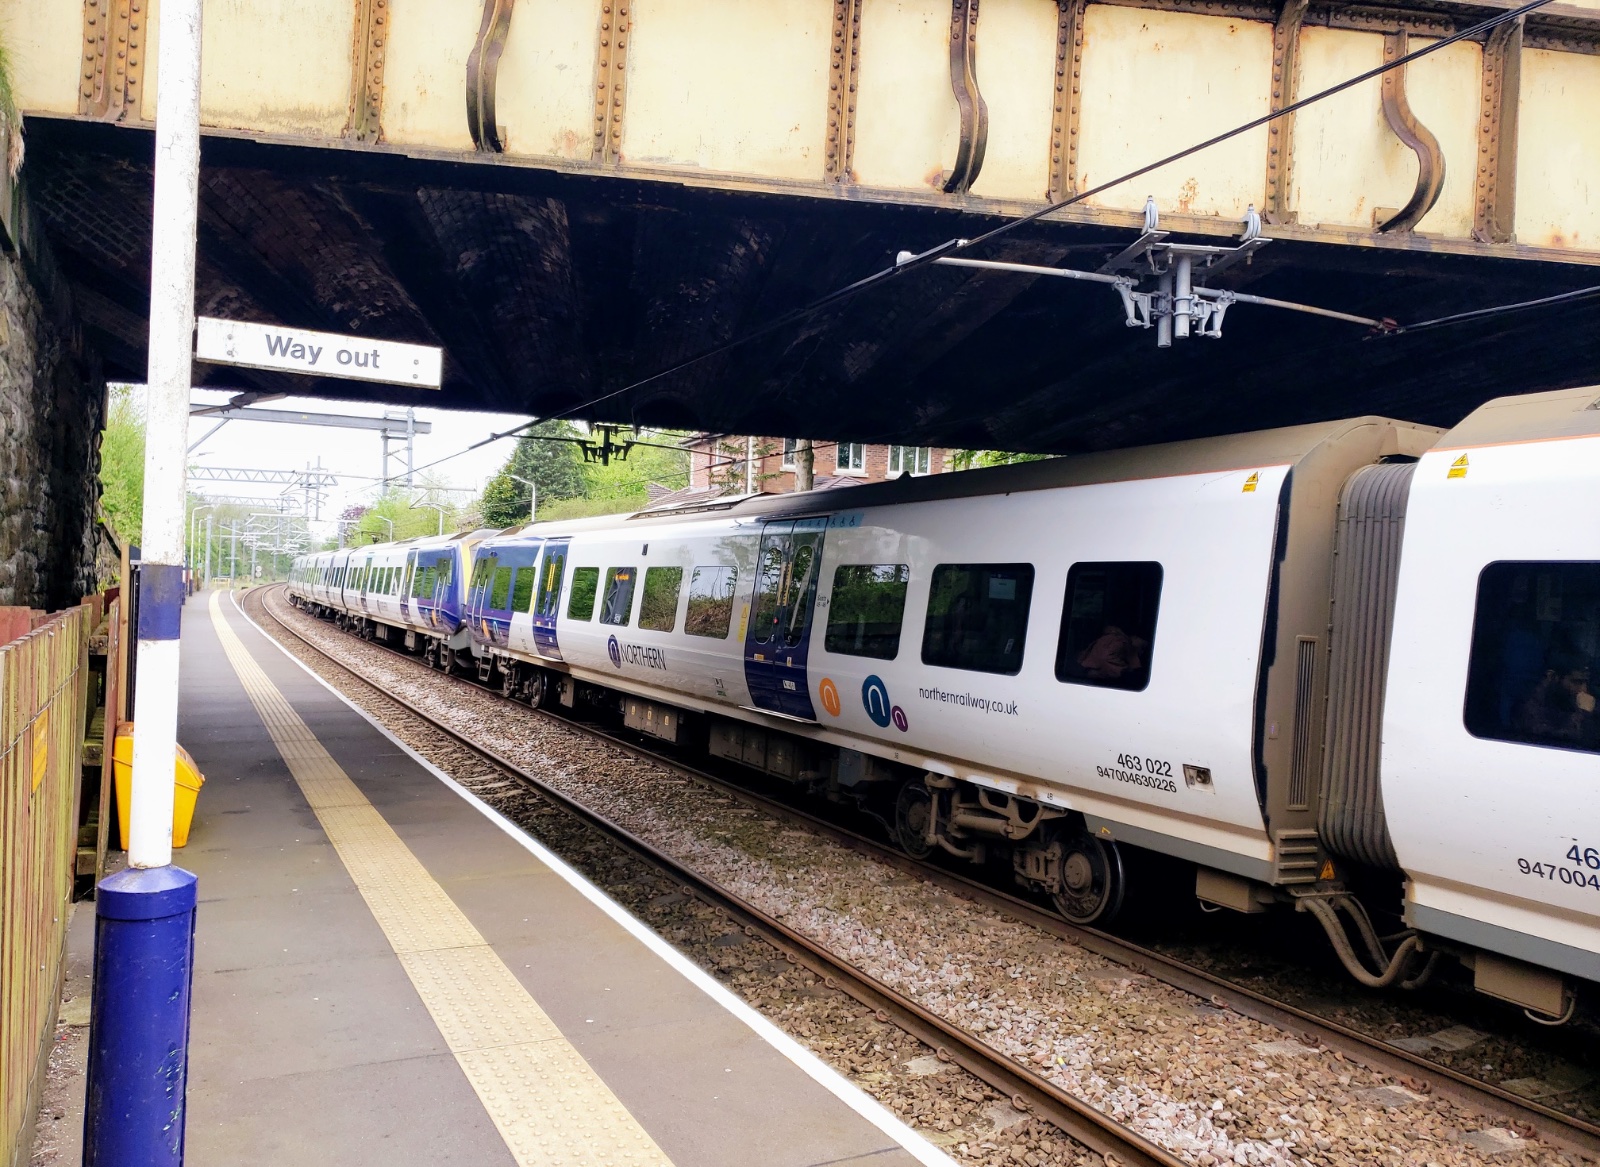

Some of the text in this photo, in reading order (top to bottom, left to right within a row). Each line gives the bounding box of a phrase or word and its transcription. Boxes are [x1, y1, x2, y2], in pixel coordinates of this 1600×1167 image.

[265, 334, 380, 369] Way out
[620, 643, 667, 670] NORTHERN
[919, 686, 1019, 716] northernrailway.co.uk
[1096, 765, 1177, 793] 947004630226
[1117, 753, 1173, 777] 463 022
[1566, 845, 1600, 870] 46
[1517, 858, 1600, 891] 947004
